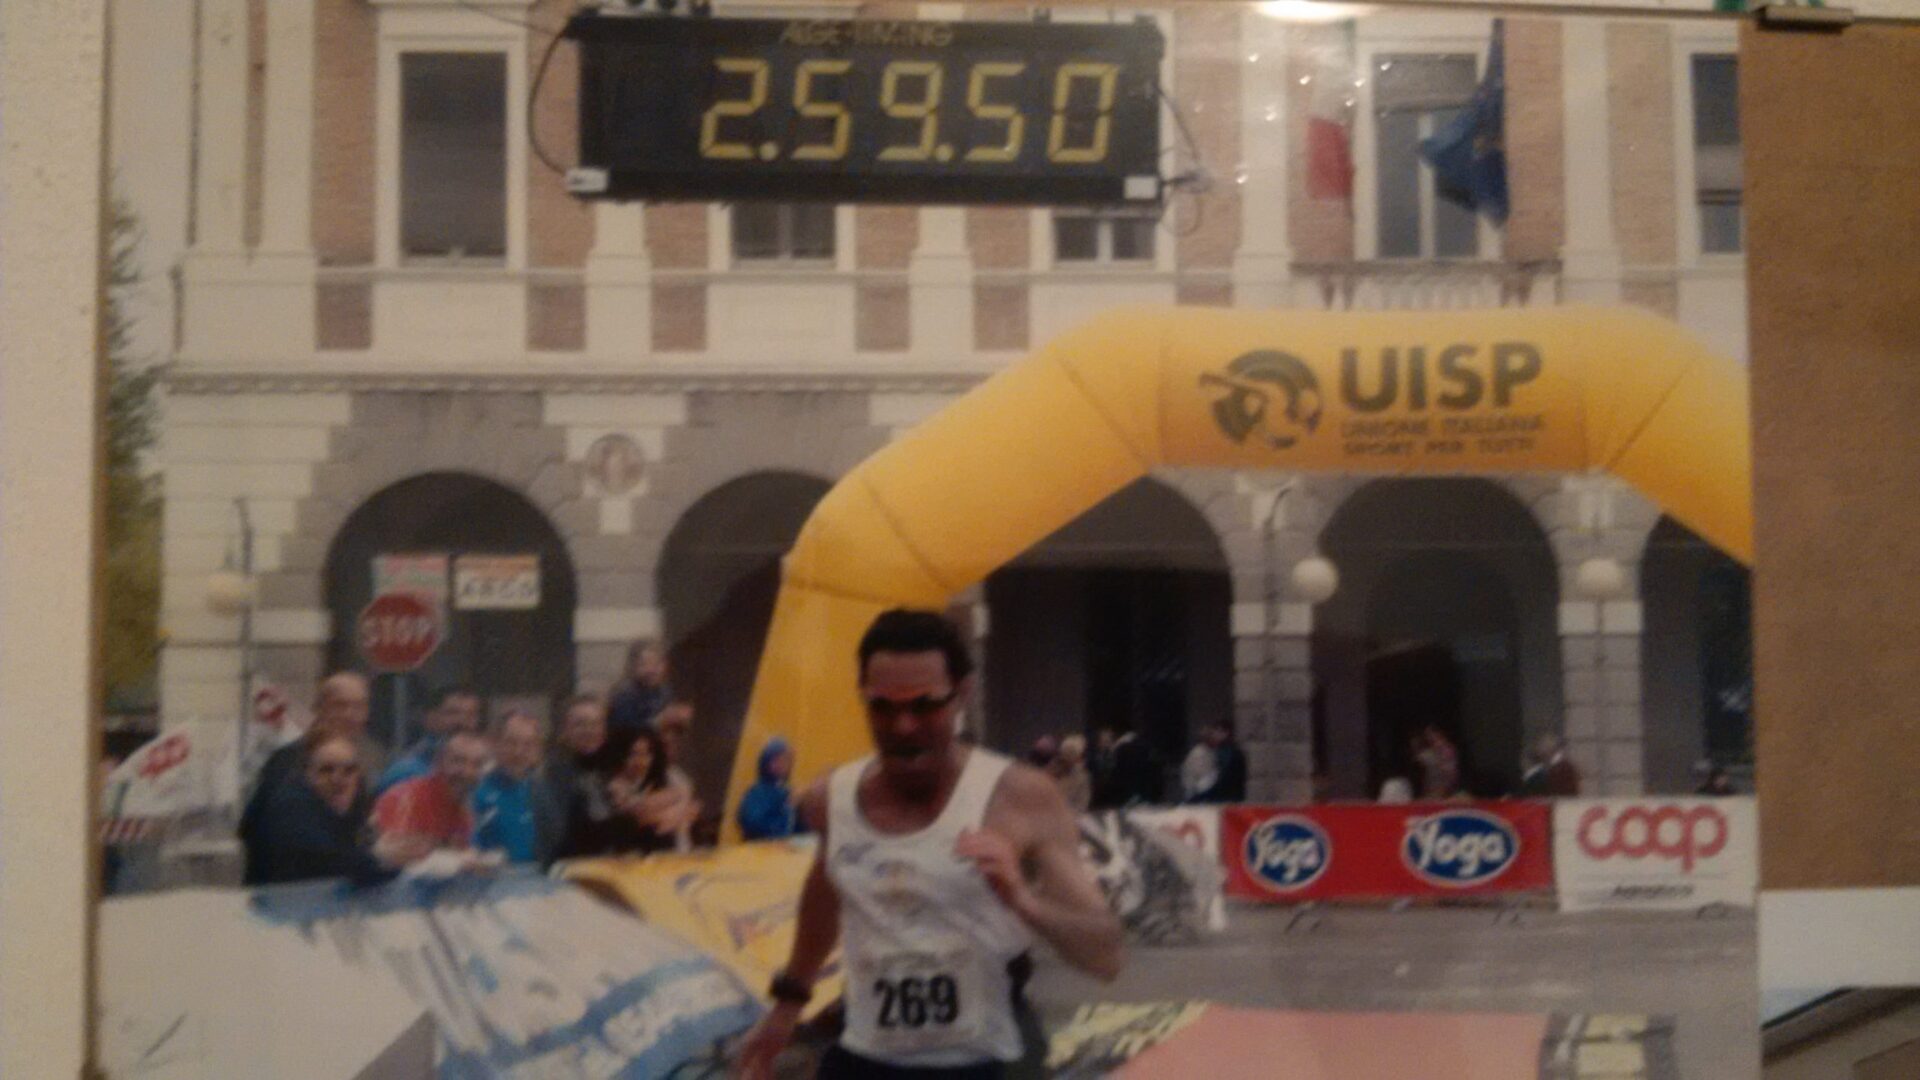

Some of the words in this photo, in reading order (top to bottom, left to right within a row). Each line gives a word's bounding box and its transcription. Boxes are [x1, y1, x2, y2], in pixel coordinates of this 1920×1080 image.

[1341, 343, 1542, 412] UISP
[363, 616, 433, 648] STOP
[1252, 825, 1319, 879] Yoga
[1412, 816, 1506, 875] Yoga
[1577, 805, 1728, 873] coop
[874, 975, 958, 1028] 269
